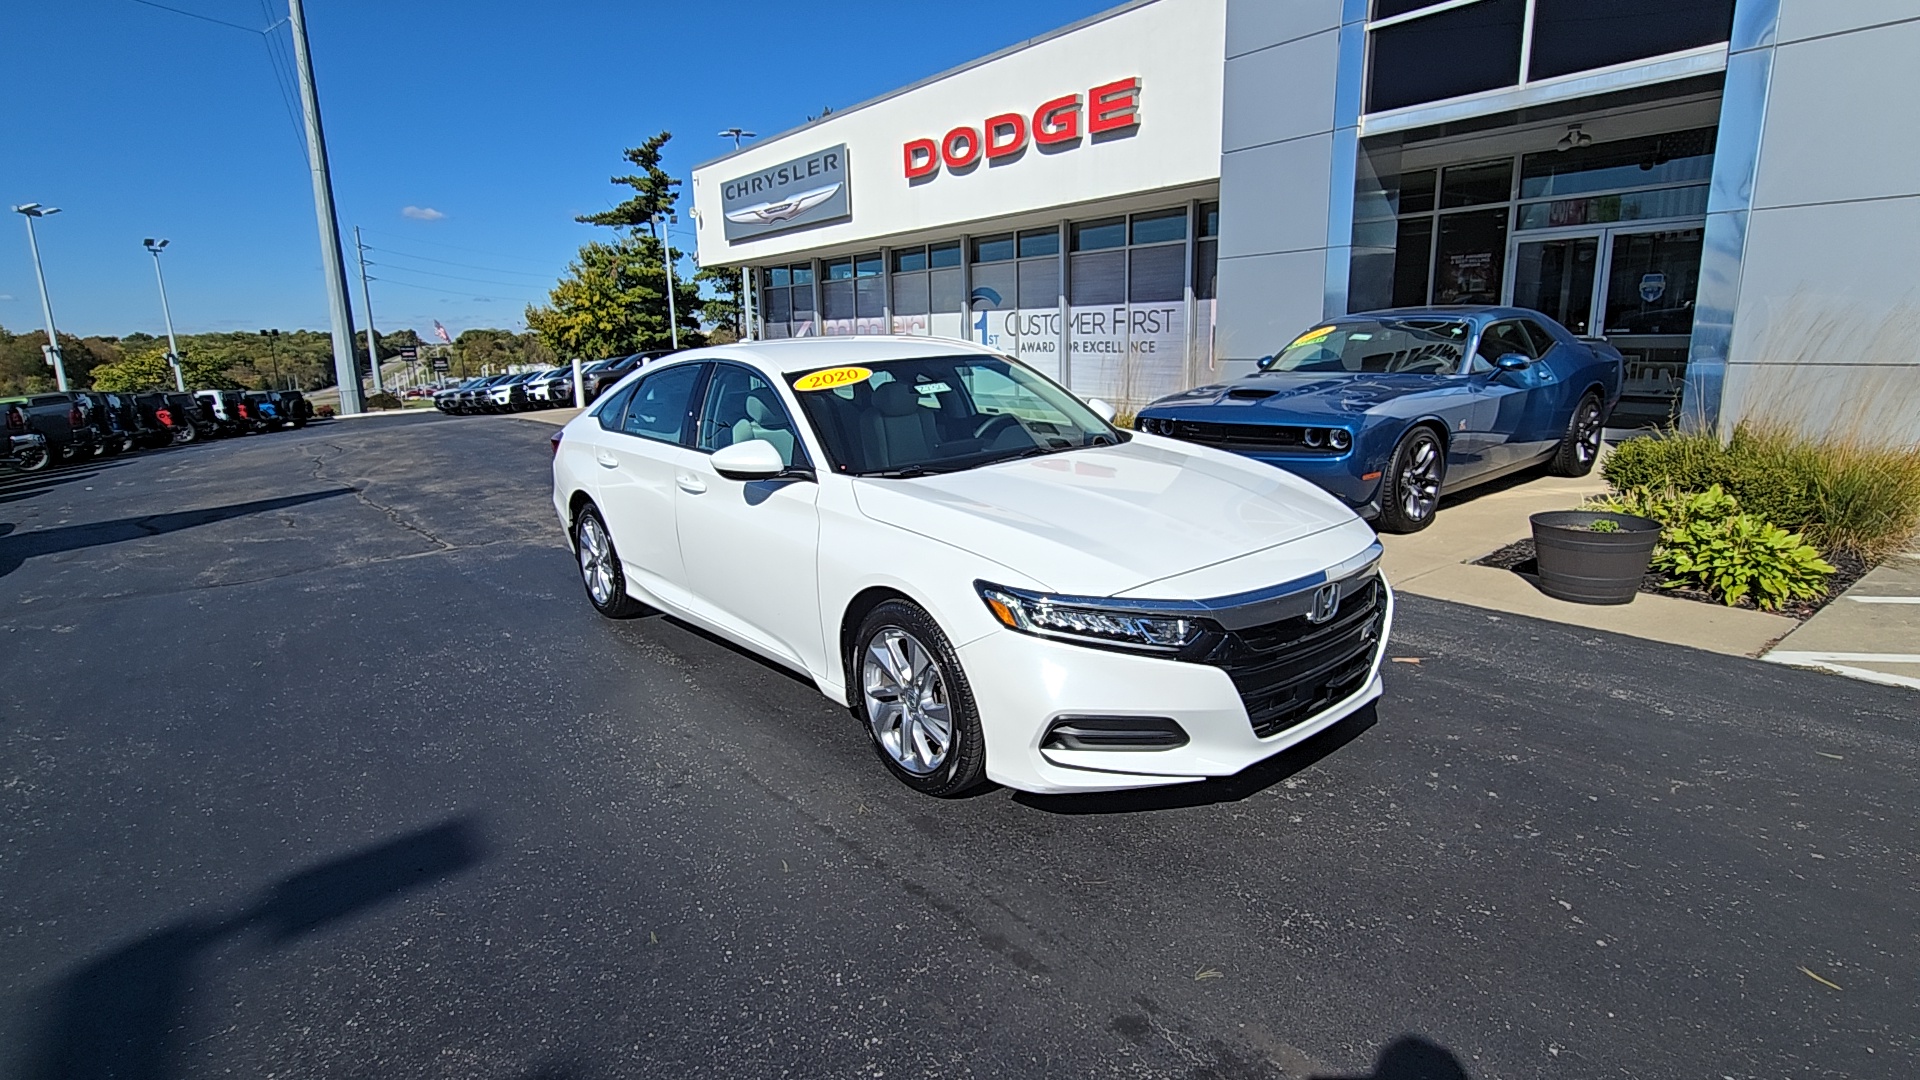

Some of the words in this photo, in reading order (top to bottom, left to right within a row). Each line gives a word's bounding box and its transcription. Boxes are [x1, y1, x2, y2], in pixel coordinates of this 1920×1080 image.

[904, 77, 1139, 179] DODGE
[725, 153, 839, 201] CHRYSLER
[1112, 307, 1175, 335] FIRST
[1020, 340, 1055, 353] AWARD
[1082, 340, 1155, 354] EXCELLNCE
[810, 369, 859, 388] 2020
